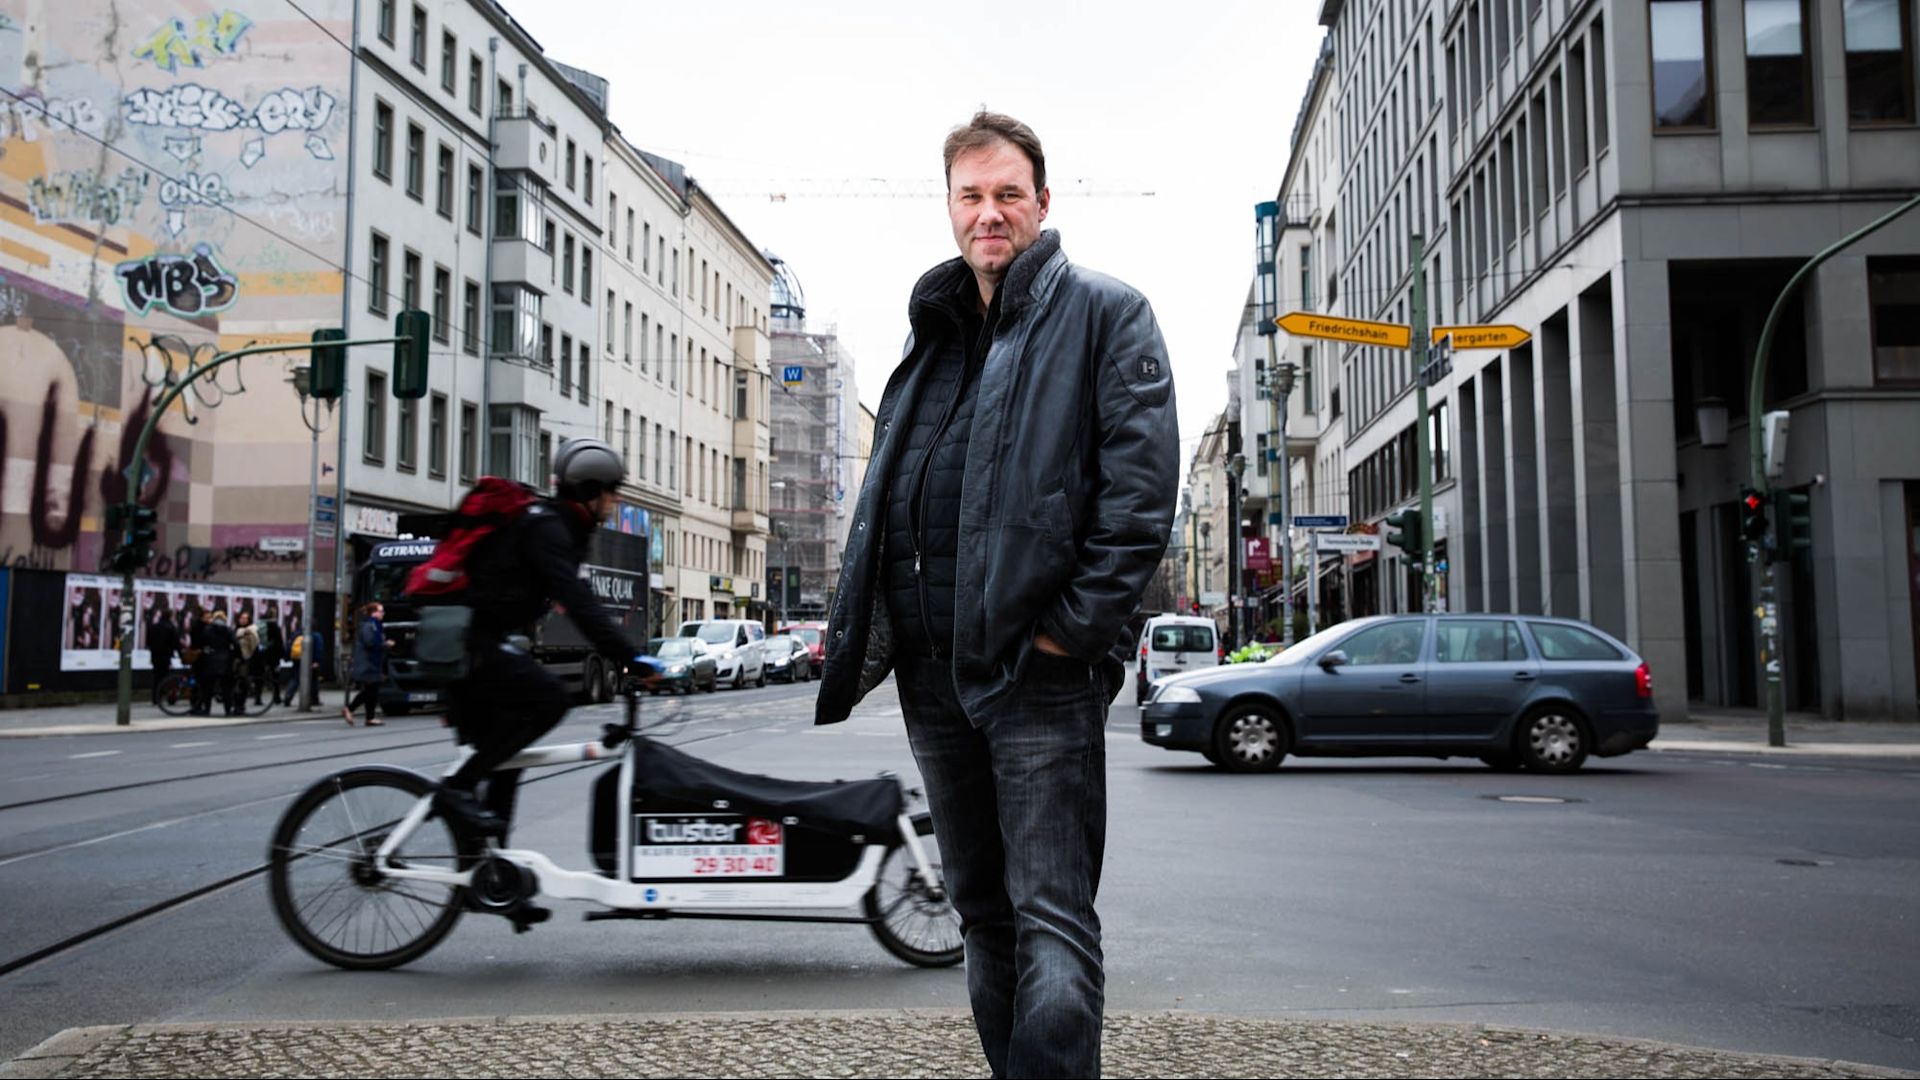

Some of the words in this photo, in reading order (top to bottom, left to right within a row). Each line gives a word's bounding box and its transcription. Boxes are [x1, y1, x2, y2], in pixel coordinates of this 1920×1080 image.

[1309, 320, 1388, 340] Friedrichshain
[1452, 332, 1508, 345] iergarten
[787, 368, 800, 380] W
[646, 818, 743, 843] twister
[719, 846, 777, 855] BERLIN
[693, 857, 719, 874] 29
[722, 856, 748, 873] 30
[752, 856, 777, 872] 40
